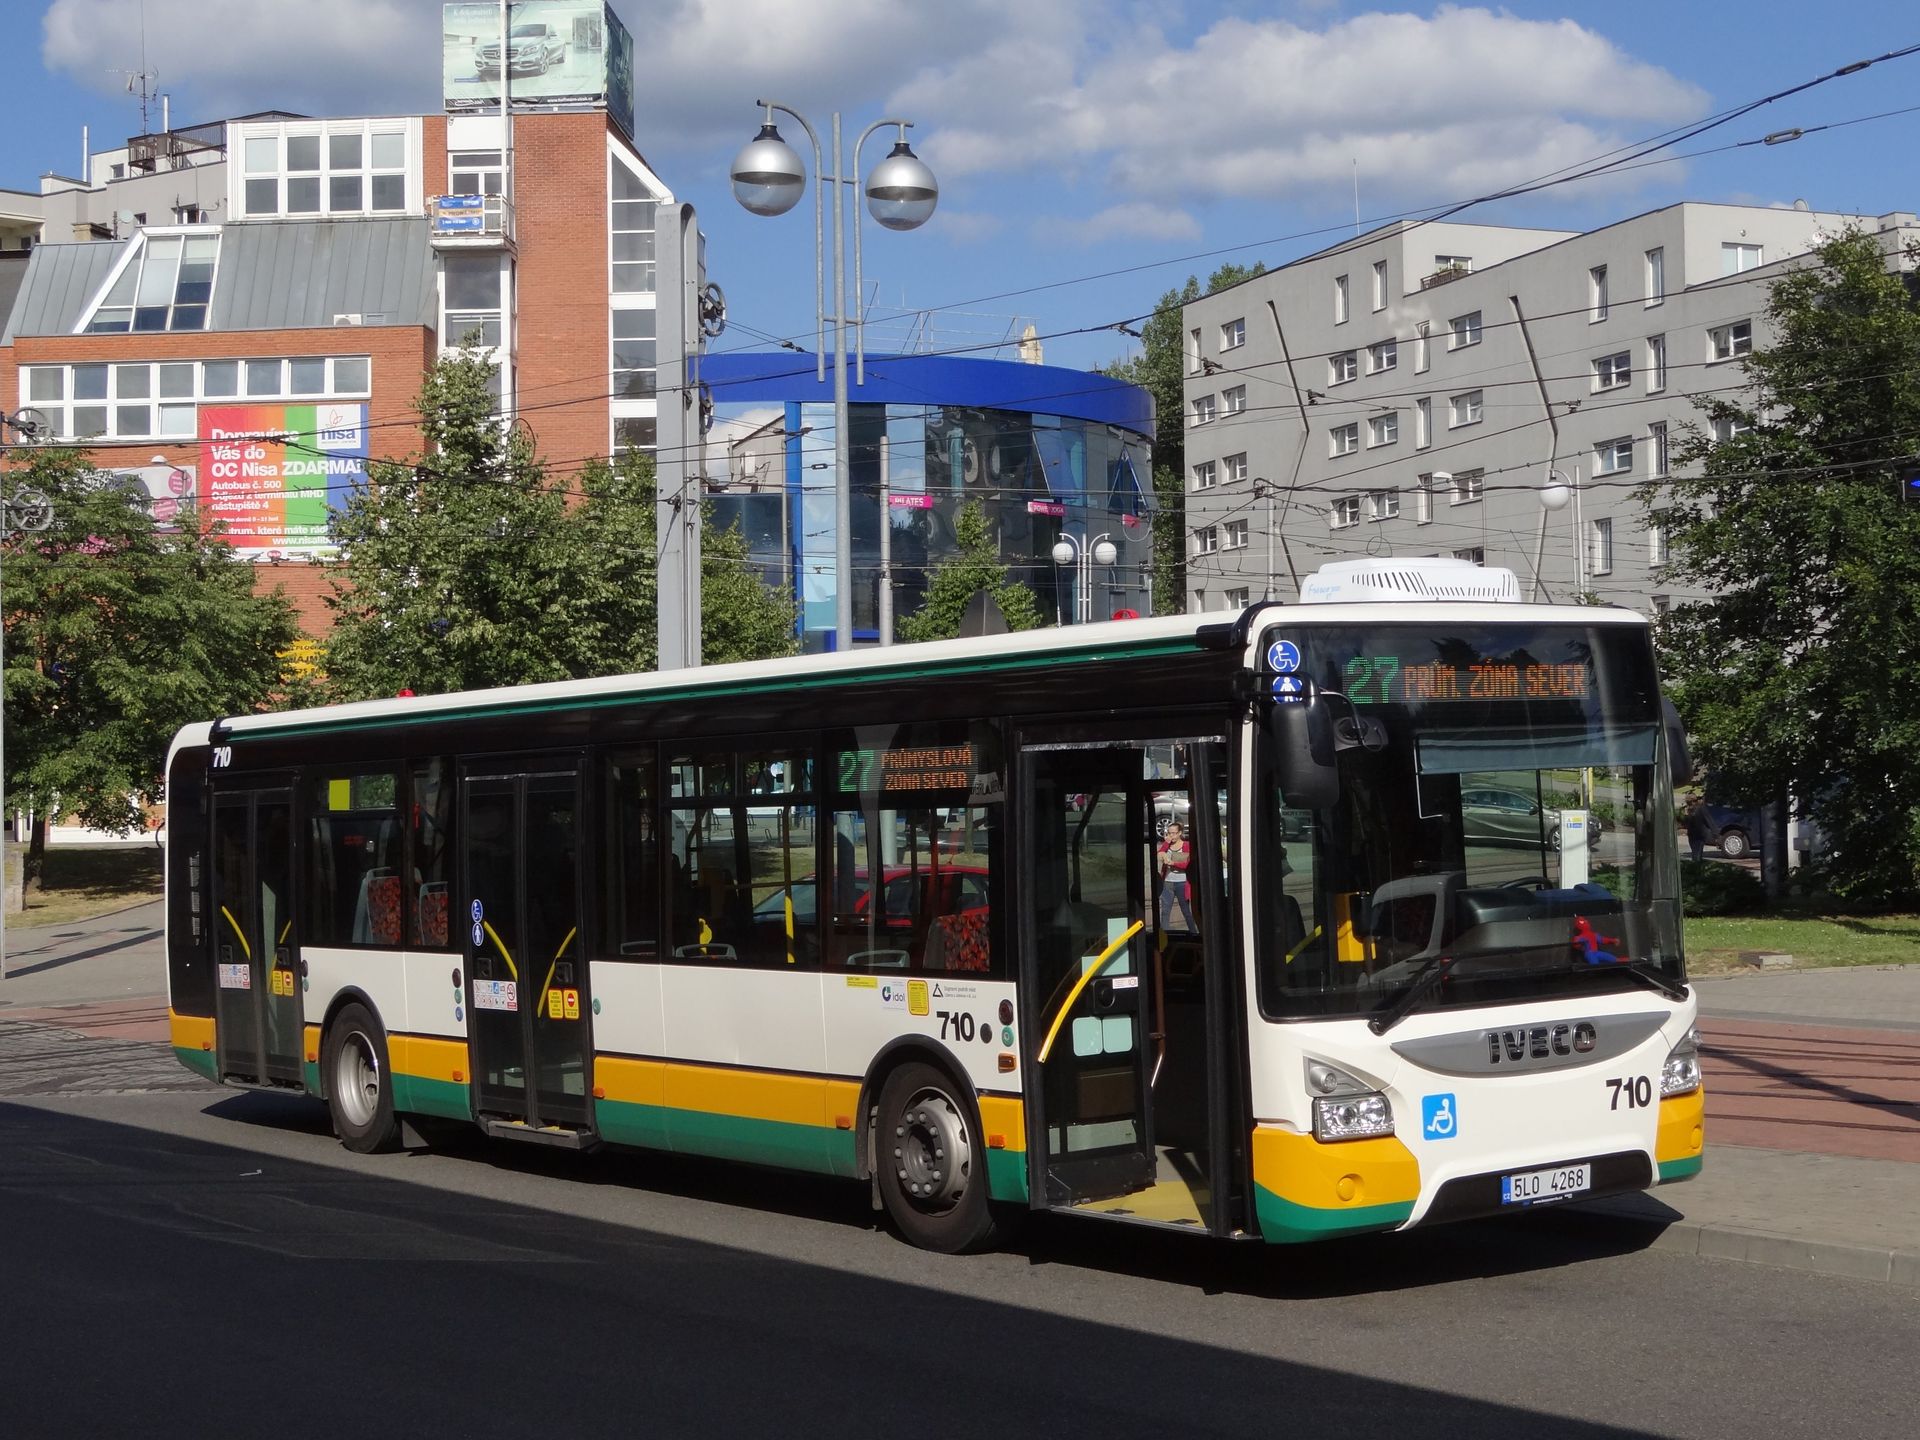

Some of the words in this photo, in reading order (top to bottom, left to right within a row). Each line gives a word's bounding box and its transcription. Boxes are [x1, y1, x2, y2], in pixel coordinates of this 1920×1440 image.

[321, 428, 356, 440] nisa
[211, 445, 241, 460] Vás
[245, 445, 266, 460] do
[211, 462, 238, 477] OC
[242, 461, 277, 476] Nisa
[211, 481, 251, 490] Autobus
[252, 480, 261, 489] č.
[263, 480, 282, 489] 500
[300, 489, 325, 498] MHD
[262, 500, 269, 509] 4
[284, 525, 309, 534] máte
[1347, 656, 1399, 704] 27
[1405, 659, 1461, 698] PRŮM.
[1469, 657, 1519, 697] ZÓNA
[1525, 664, 1586, 696] SEVER
[213, 746, 232, 767] 710
[881, 743, 972, 769] PRŮMYSLOVÁ
[839, 750, 875, 792] 27
[885, 772, 921, 790] ZÓNA
[923, 771, 968, 789] SEVER
[936, 1011, 975, 1042] 710
[1488, 1021, 1597, 1064] IVECO
[1605, 1075, 1652, 1110] 710
[1550, 1169, 1584, 1191] 4268
